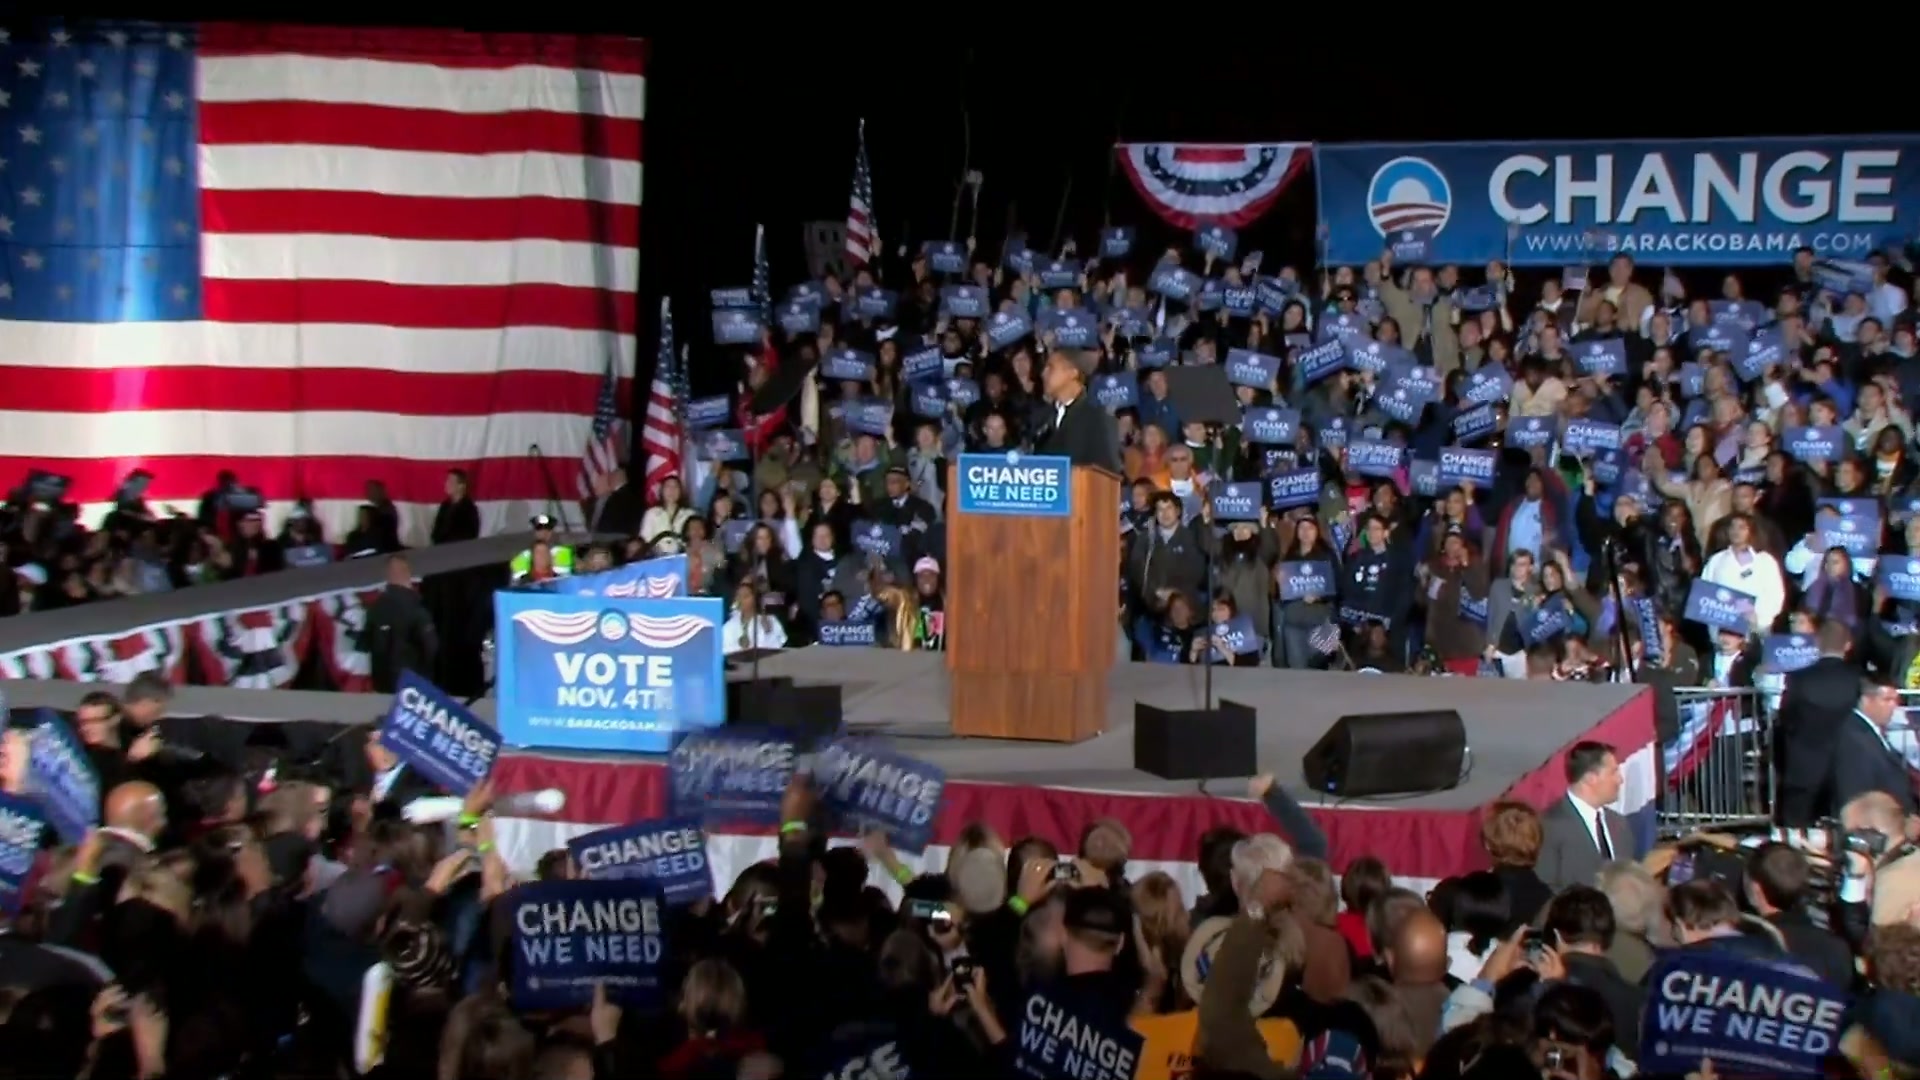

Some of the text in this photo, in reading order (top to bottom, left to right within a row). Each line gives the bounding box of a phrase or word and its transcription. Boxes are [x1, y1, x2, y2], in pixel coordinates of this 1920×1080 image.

[1488, 150, 1899, 224] CHANGE
[1225, 288, 1256, 299] CHAN
[1234, 363, 1268, 377] OBAMA
[1253, 421, 1289, 431] OBAMA
[1320, 430, 1346, 439] OBAM
[1792, 441, 1833, 450] OBAMA
[1442, 453, 1494, 467] CHANGE
[968, 466, 1058, 485] CHANGE
[1271, 472, 1318, 488] CHANGE
[969, 485, 1058, 502] WE NEED
[1215, 497, 1251, 506] OBAMA
[1289, 576, 1325, 586] OBAMA
[1889, 573, 1920, 584] OBA
[821, 625, 874, 635] CHANGE
[554, 652, 673, 687] VOTE
[557, 686, 618, 709] NOV.
[400, 687, 498, 763] CHANGE
[394, 710, 431, 740] WE
[431, 733, 489, 777] NEED
[580, 829, 700, 869] CHANGE
[655, 850, 704, 878] EED
[516, 899, 660, 935] CHANGE
[521, 935, 661, 966] WE NEED
[1661, 970, 1846, 1030] CHANGE
[1026, 994, 1134, 1080] CHANGE
[1658, 1003, 1830, 1055] WE NEED
[1020, 1020, 1058, 1064] WE
